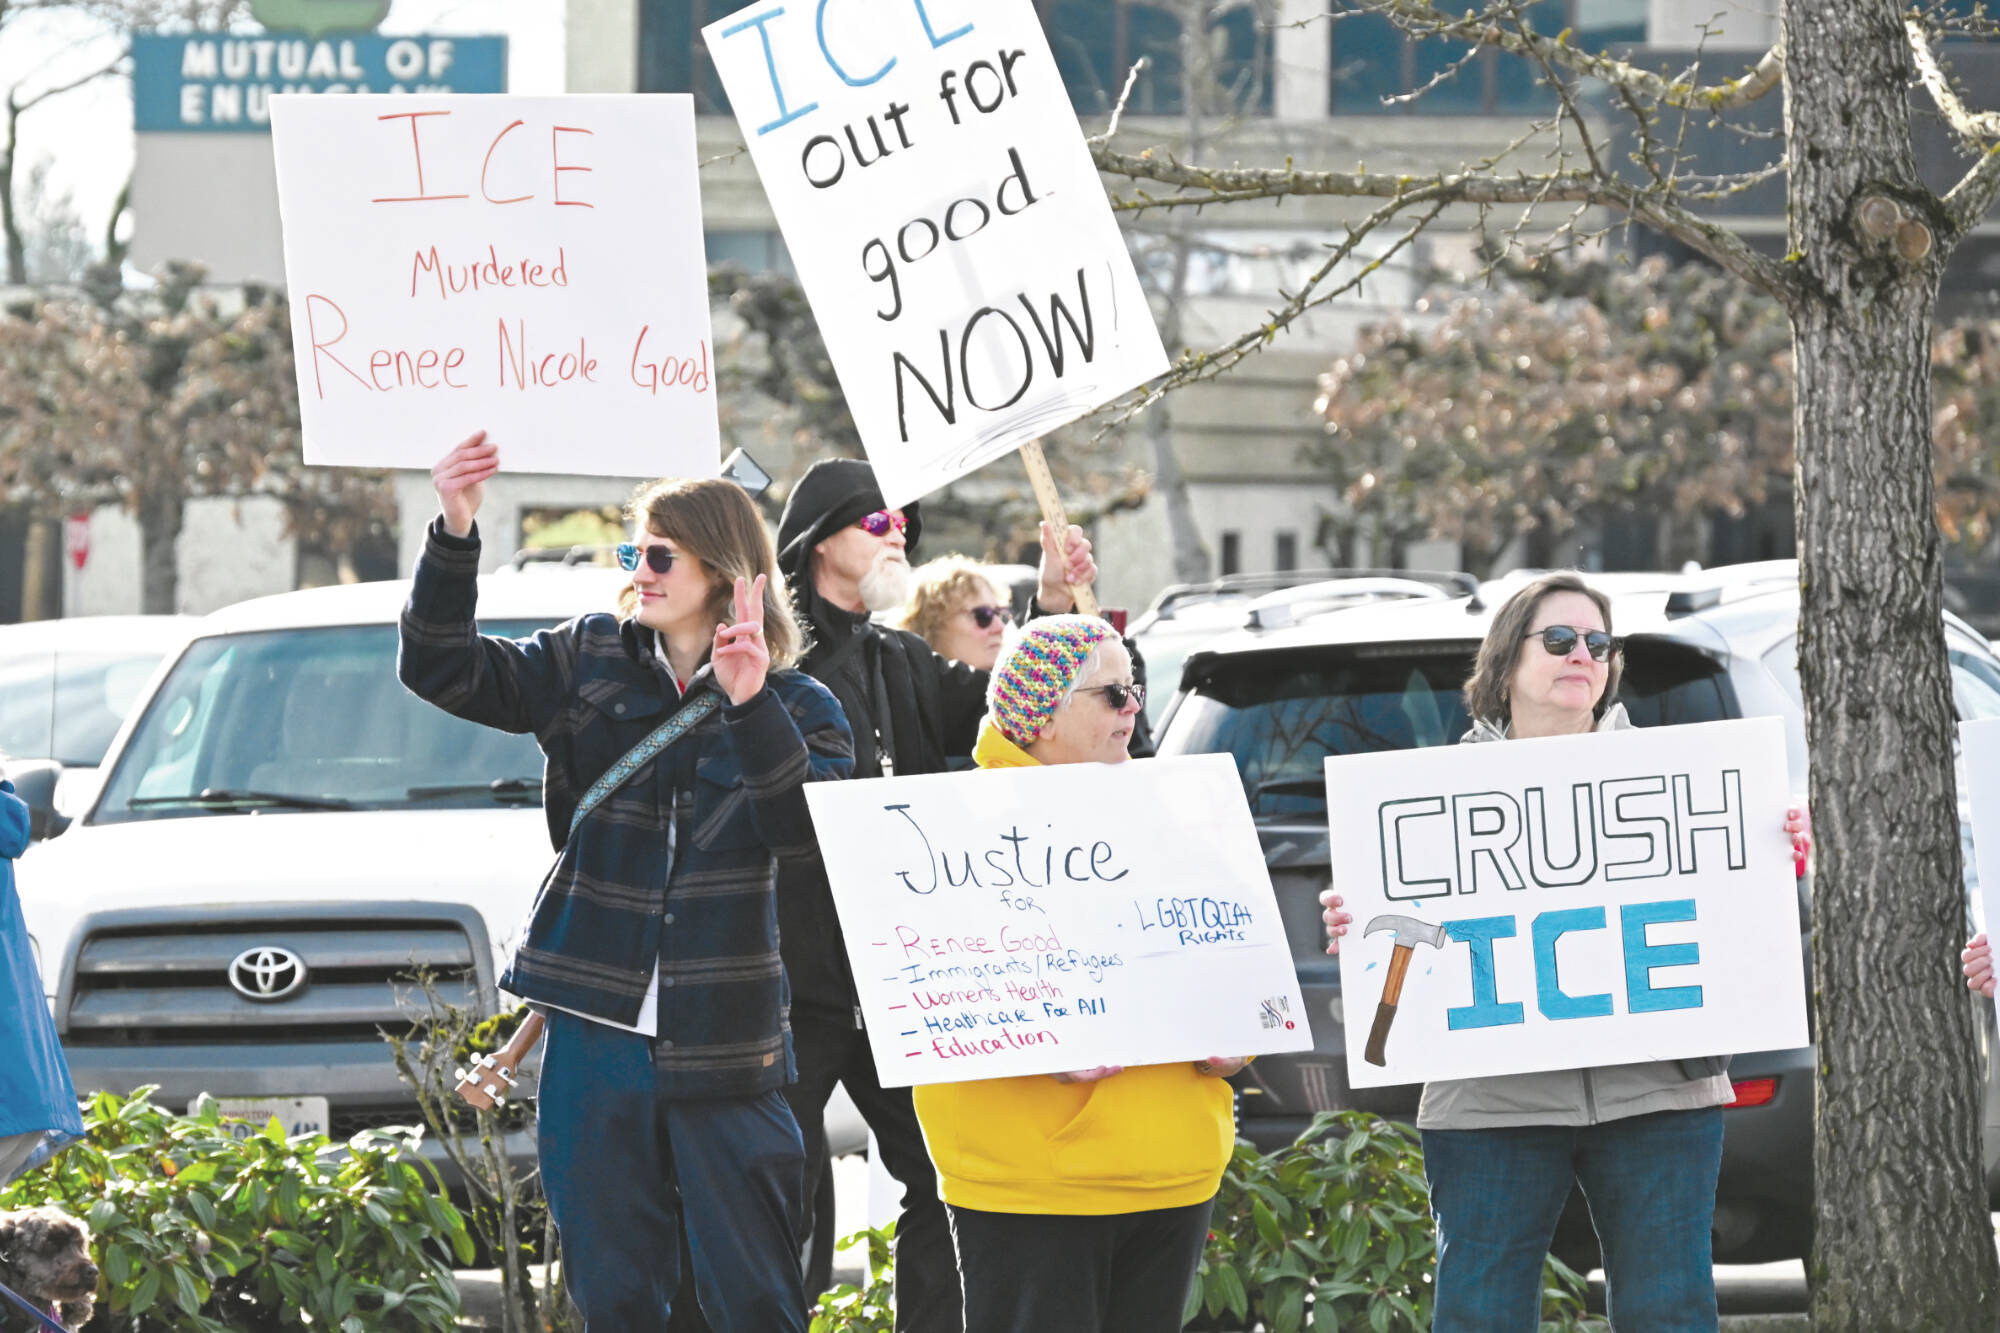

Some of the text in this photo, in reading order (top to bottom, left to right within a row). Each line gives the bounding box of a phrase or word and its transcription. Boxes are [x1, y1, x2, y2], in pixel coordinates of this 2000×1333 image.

[181, 40, 455, 80] MUTUAL OF
[371, 110, 594, 209] ICE
[801, 49, 1026, 189] out for
[411, 244, 568, 300] Murdered
[862, 146, 1042, 322] good
[306, 294, 709, 400] Renee Nicole Good
[883, 804, 1130, 894] Justice
[1378, 769, 1747, 902] CRUSH
[1000, 923, 1063, 953] Good
[1441, 898, 1704, 1031] ICE
[1005, 979, 1064, 1001] Health
[1078, 997, 1106, 1016] All
[931, 1028, 1059, 1059] Education
